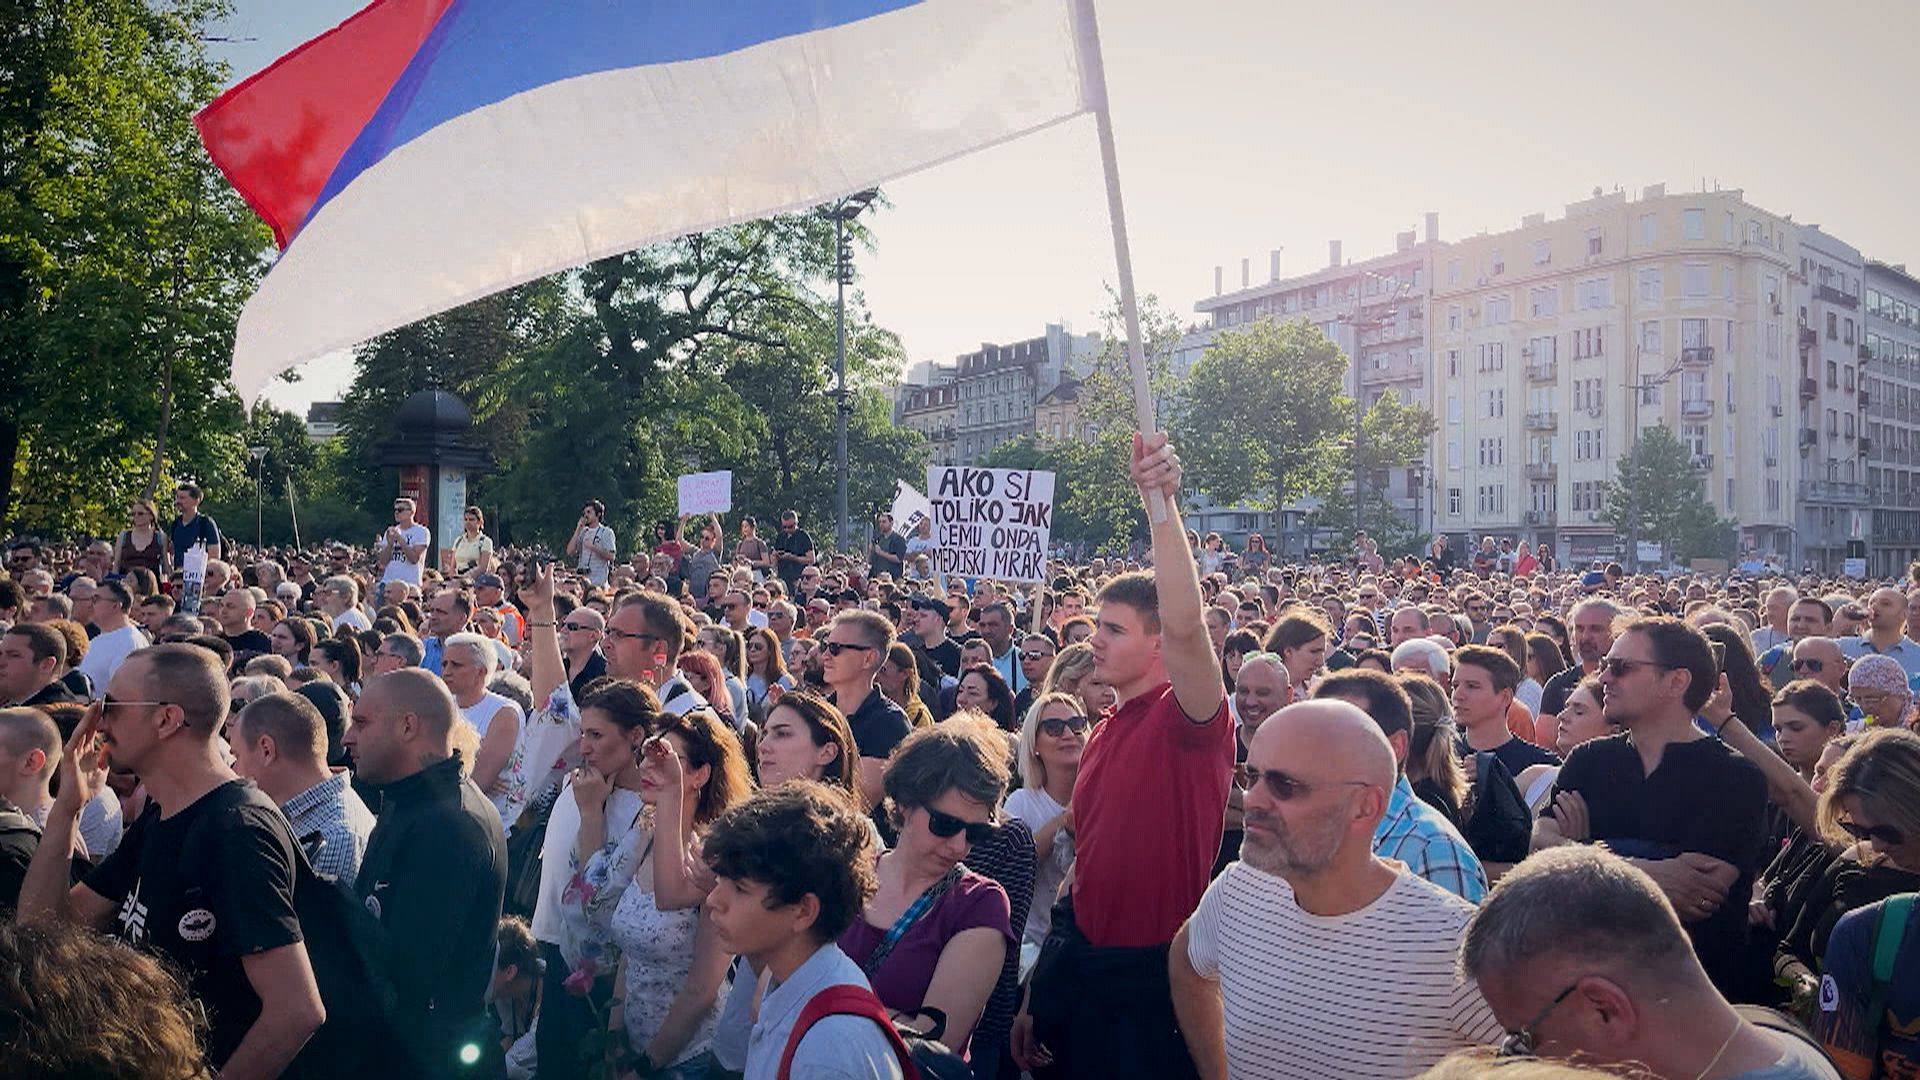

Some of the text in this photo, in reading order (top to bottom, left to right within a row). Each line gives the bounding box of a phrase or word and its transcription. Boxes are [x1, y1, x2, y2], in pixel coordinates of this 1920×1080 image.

[938, 468, 1033, 500] AKO SI
[1009, 502, 1051, 530] JAK
[991, 527, 1042, 553] ONDA
[993, 550, 1044, 579] MRAK
